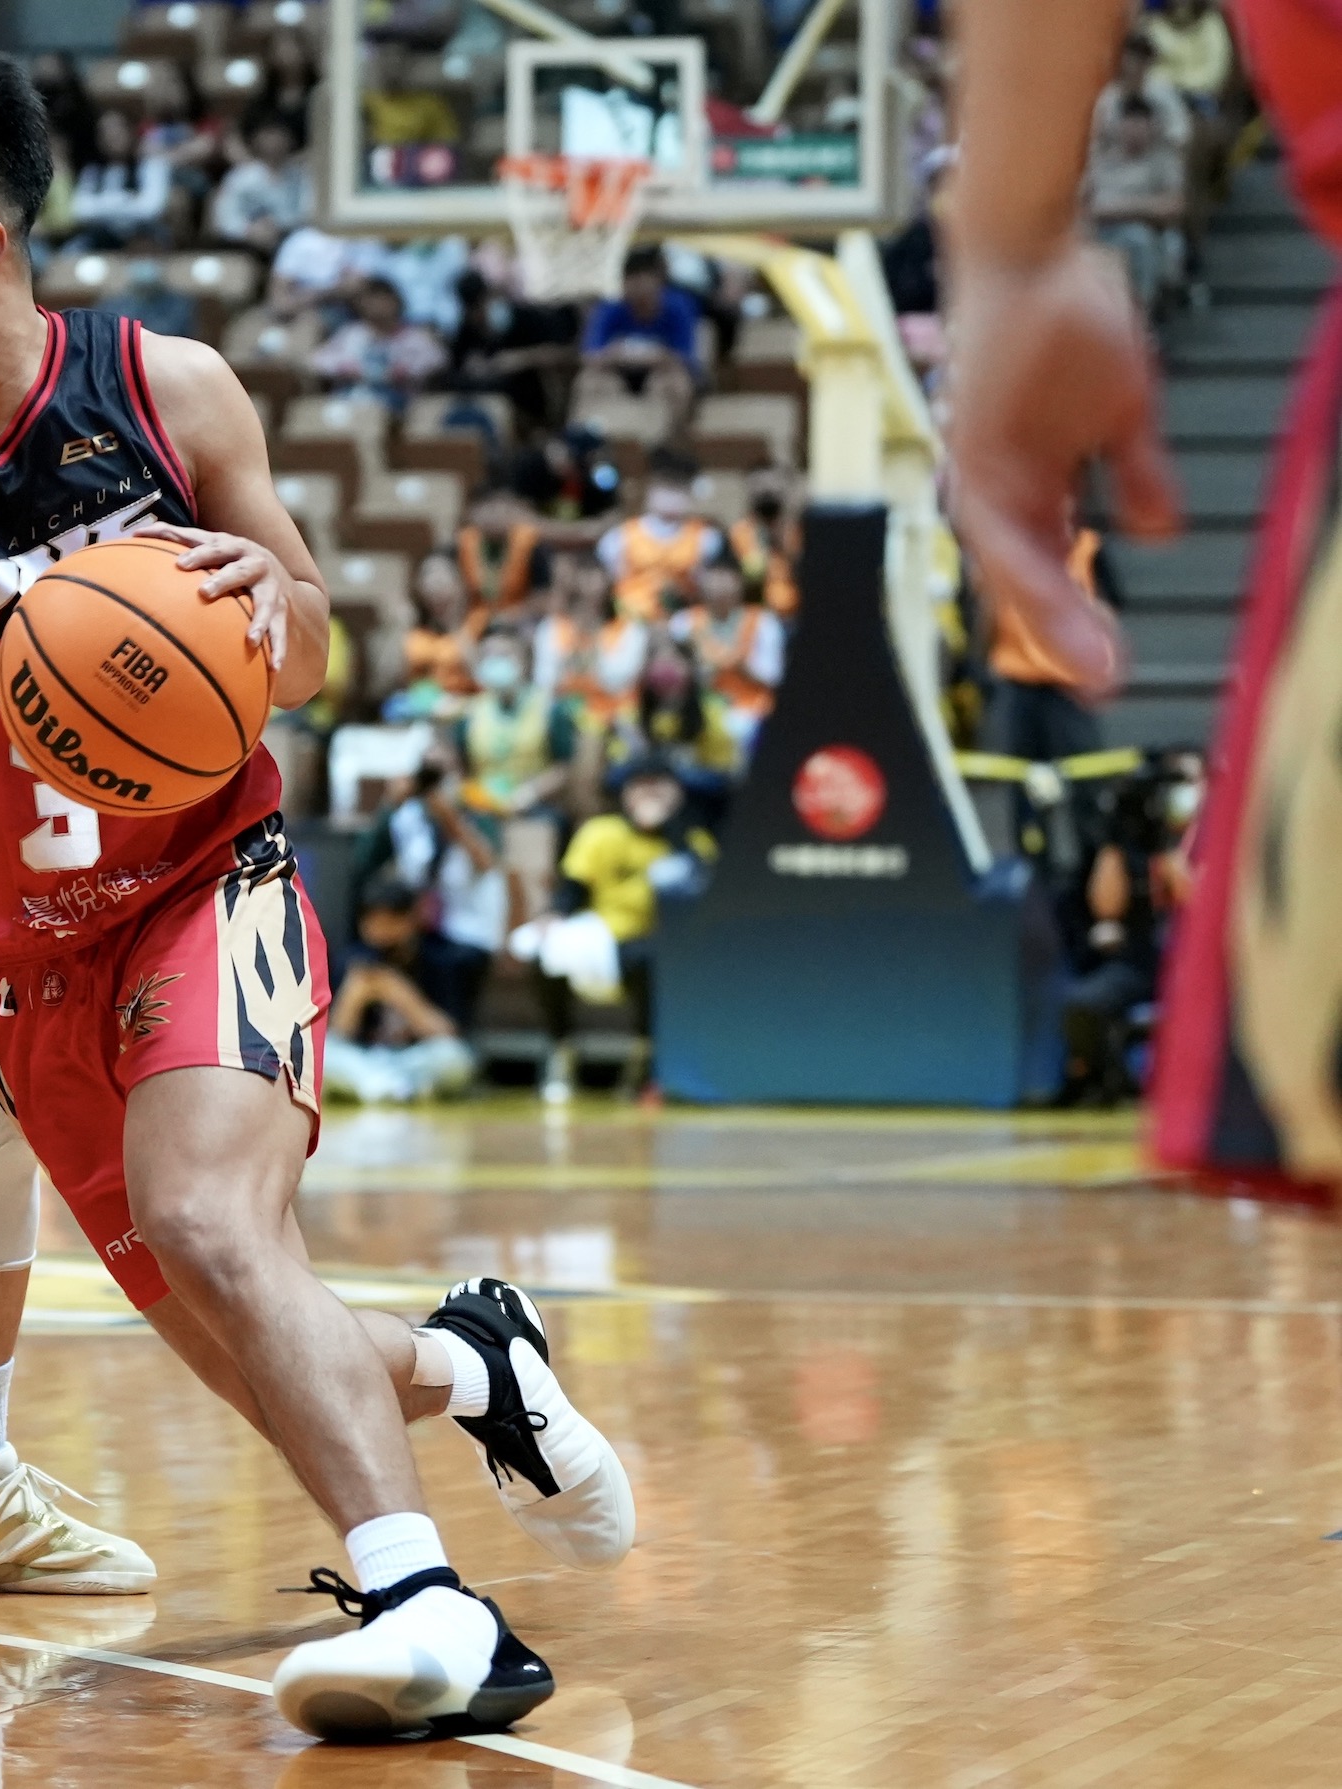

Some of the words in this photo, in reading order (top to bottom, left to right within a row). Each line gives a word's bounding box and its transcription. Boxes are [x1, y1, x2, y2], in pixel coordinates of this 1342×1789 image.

[100, 660, 151, 705] APPROVED
[111, 637, 169, 694] FIBA
[11, 658, 153, 802] Wilson
[105, 1226, 144, 1262] AR
